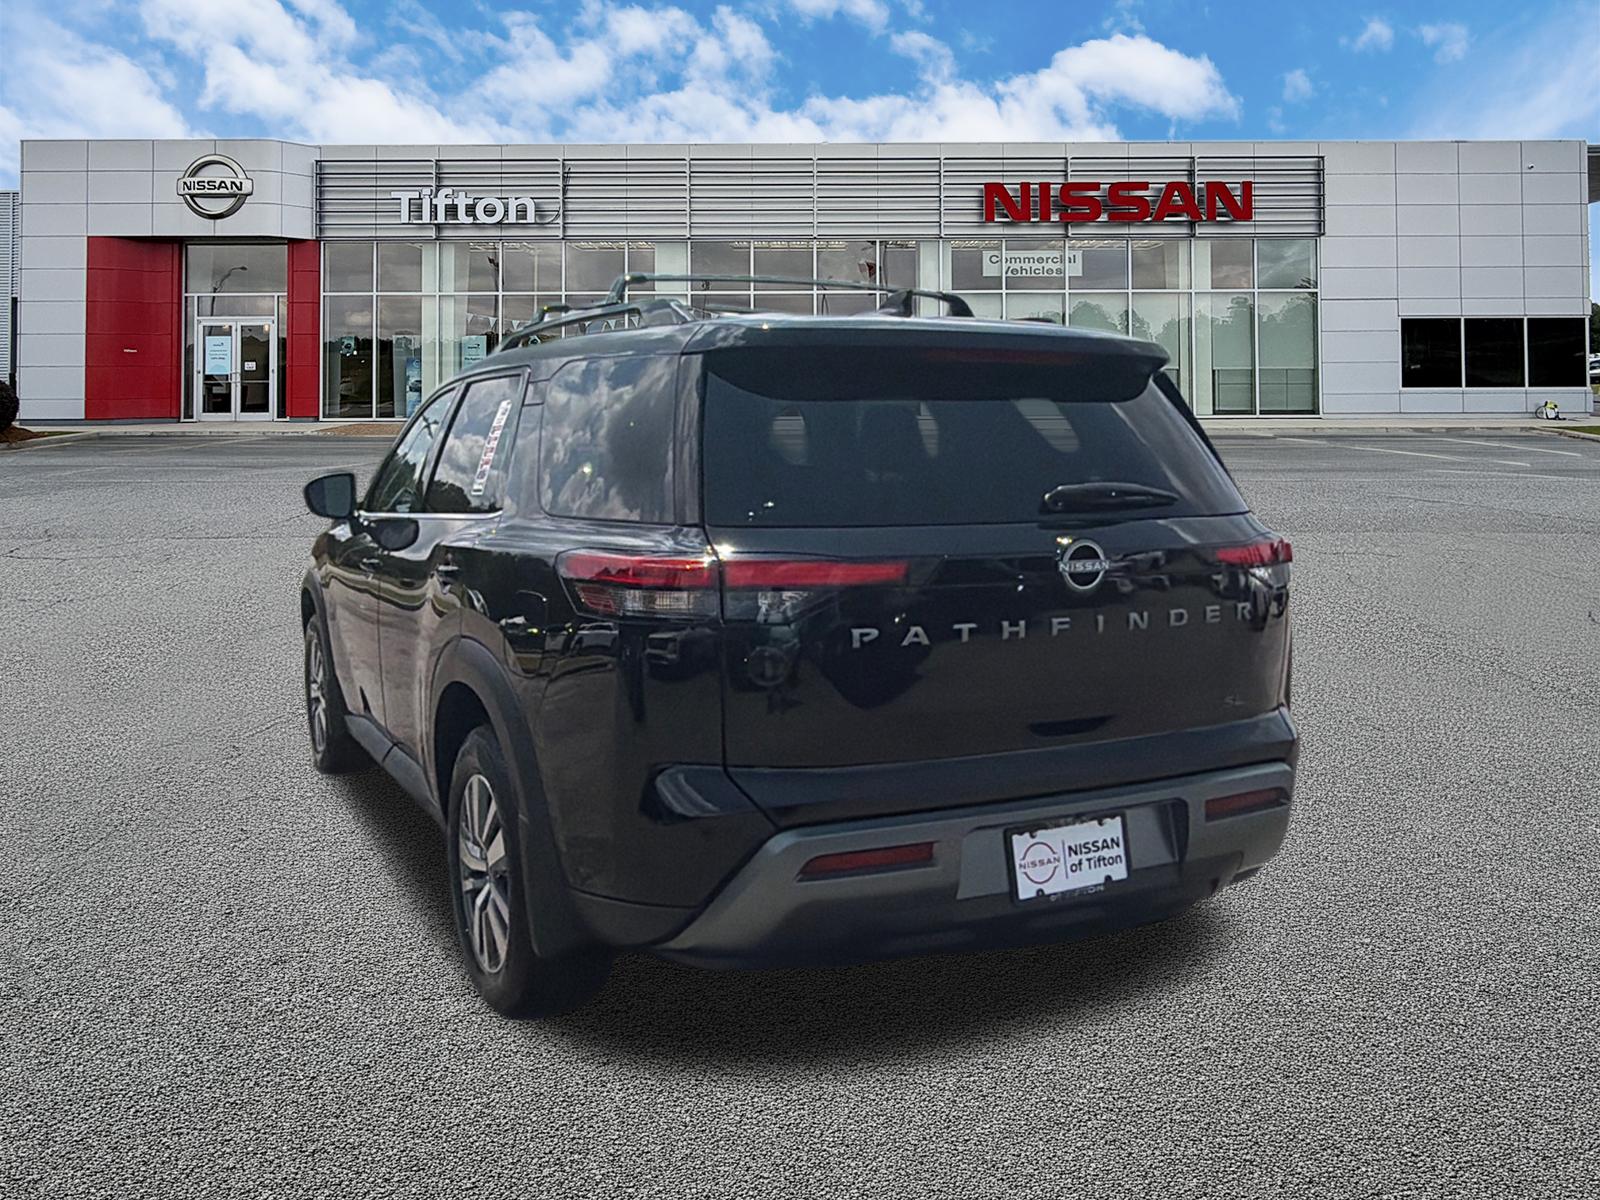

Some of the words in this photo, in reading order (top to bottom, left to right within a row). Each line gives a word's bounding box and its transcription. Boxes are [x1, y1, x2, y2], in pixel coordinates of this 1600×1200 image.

[182, 180, 243, 191] NISSAN
[391, 188, 536, 224] Tifton
[983, 181, 1253, 222] NISSAN
[1059, 560, 1110, 573] NISSAN
[851, 602, 1252, 648] PATHFINDER
[1068, 837, 1120, 857] NISSAN
[1018, 857, 1060, 870] NISSAN
[1070, 860, 1084, 873] of
[1085, 854, 1123, 870] Tifton
